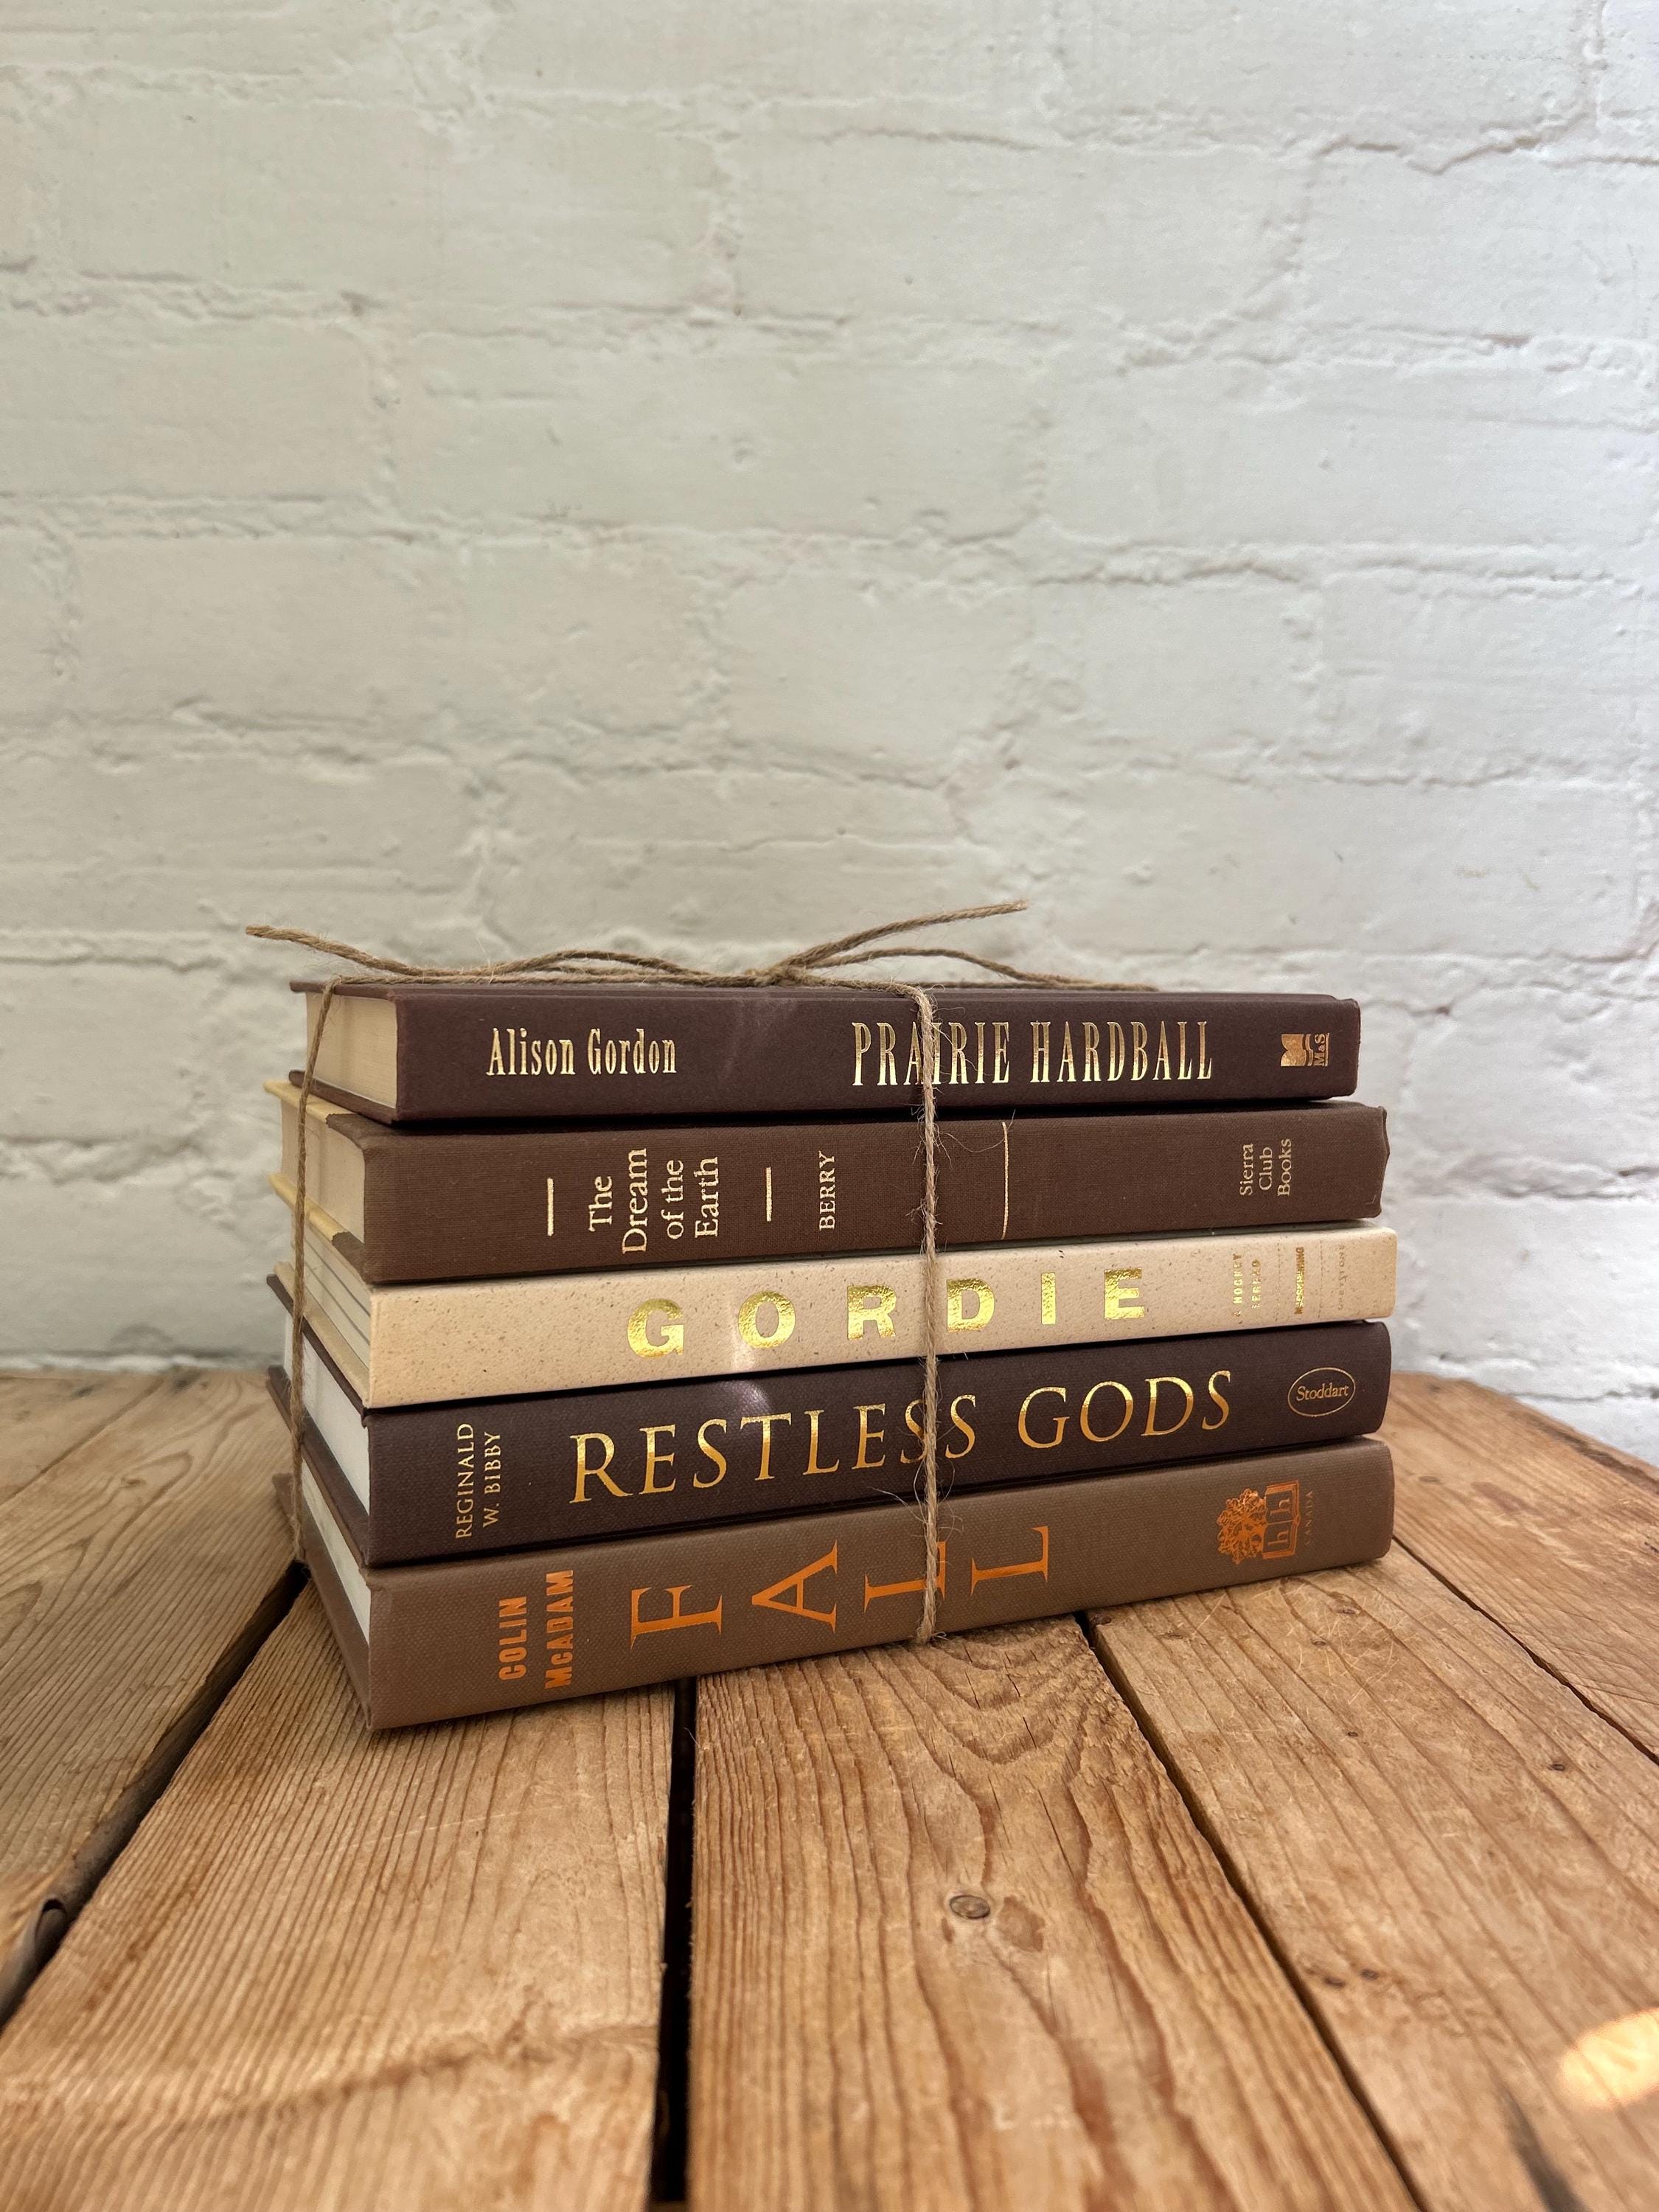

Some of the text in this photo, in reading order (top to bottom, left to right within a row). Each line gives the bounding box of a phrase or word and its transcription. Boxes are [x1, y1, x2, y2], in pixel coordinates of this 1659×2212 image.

[486, 1028, 677, 1076] Alison Gordon
[852, 1020, 1213, 1086] PRAIRIE HARDBALL
[588, 1175, 613, 1232] The
[622, 1147, 648, 1254] Dream
[661, 1159, 684, 1239] of the
[693, 1156, 720, 1239] Earth
[818, 1151, 836, 1231] BERRY
[1239, 1143, 1253, 1196] Sierra
[1259, 1146, 1273, 1191] Club
[1277, 1138, 1292, 1197] Books
[627, 1266, 1146, 1359] GORDIE
[1295, 1382, 1349, 1402] Stoddart
[568, 1369, 1233, 1506] RESTLESS GODS
[456, 1423, 474, 1539] REGINALD
[483, 1431, 501, 1528] W. BIBBY
[498, 1596, 527, 1681] COLIN
